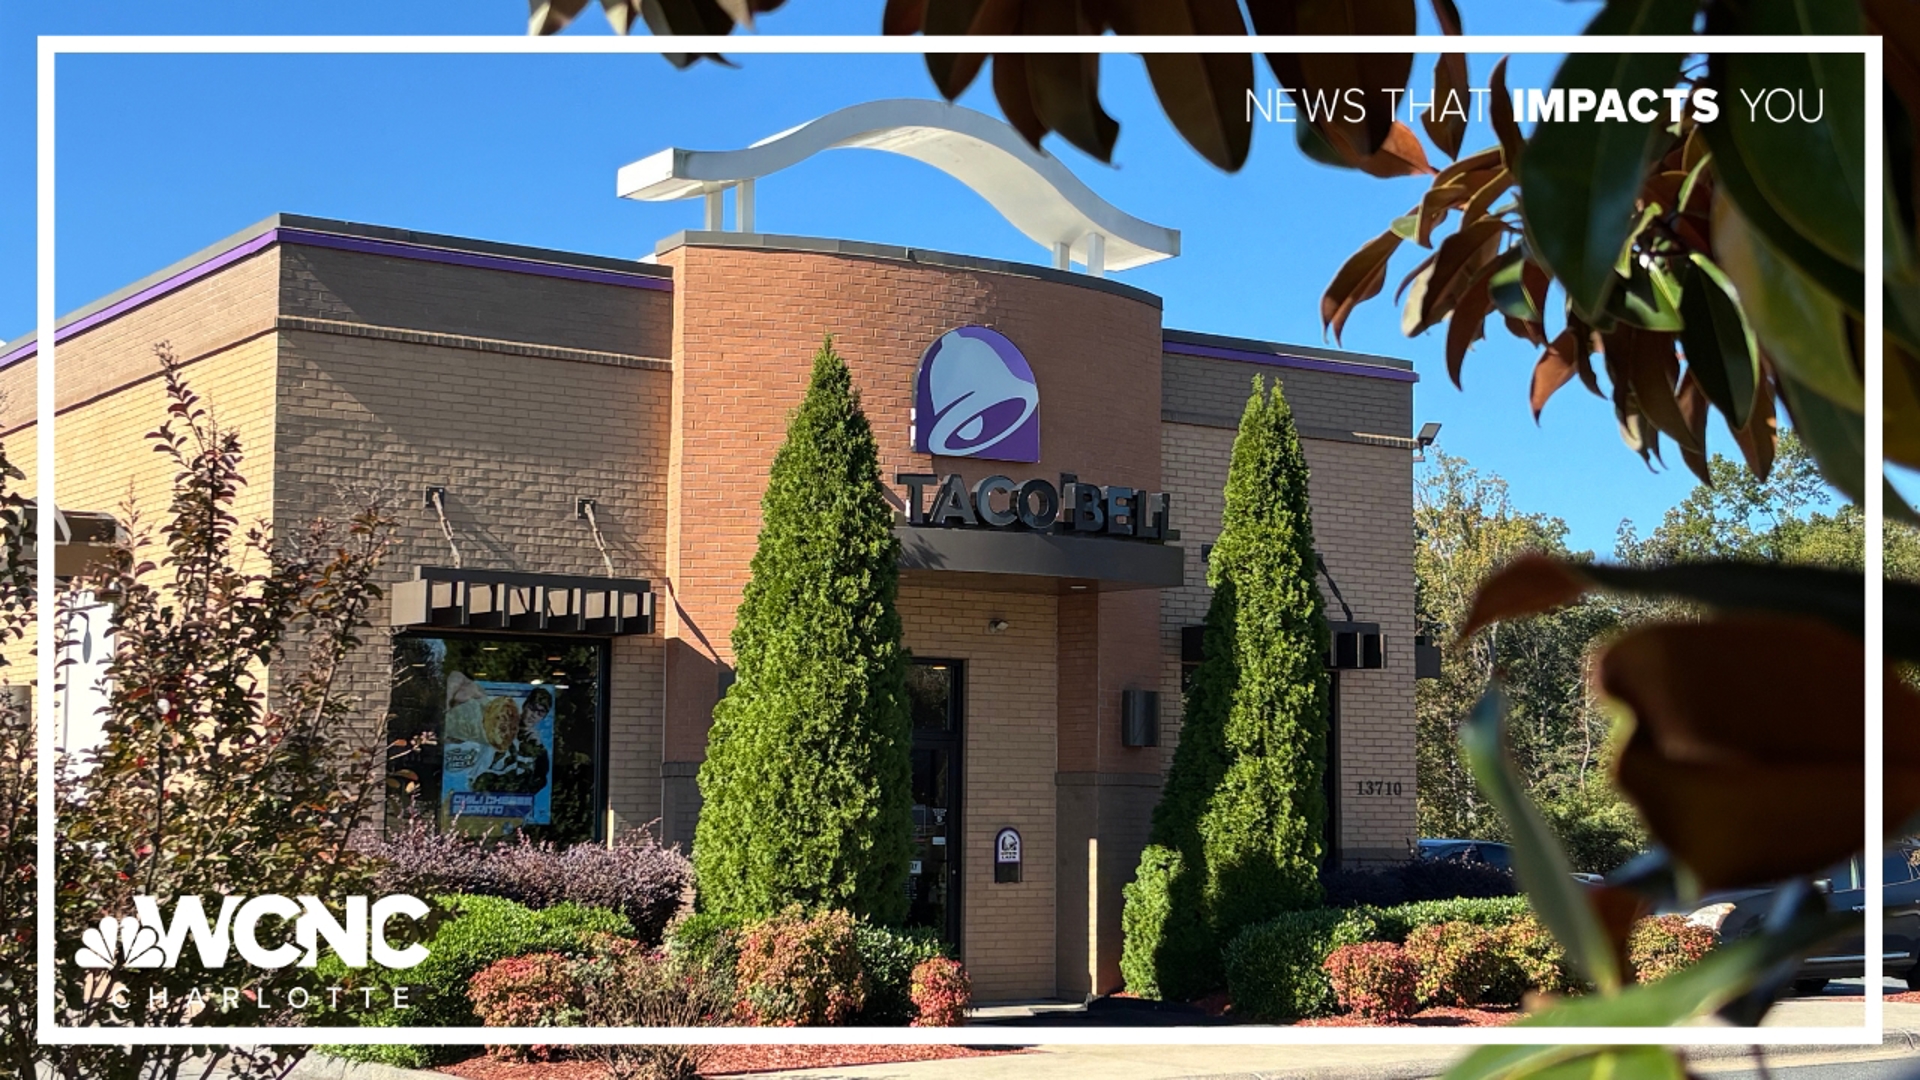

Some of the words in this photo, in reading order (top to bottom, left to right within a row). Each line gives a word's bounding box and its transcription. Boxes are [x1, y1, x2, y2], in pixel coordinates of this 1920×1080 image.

[895, 474, 1059, 529] TACO
[1065, 481, 1181, 541] BELL
[1357, 780, 1402, 796] 13710
